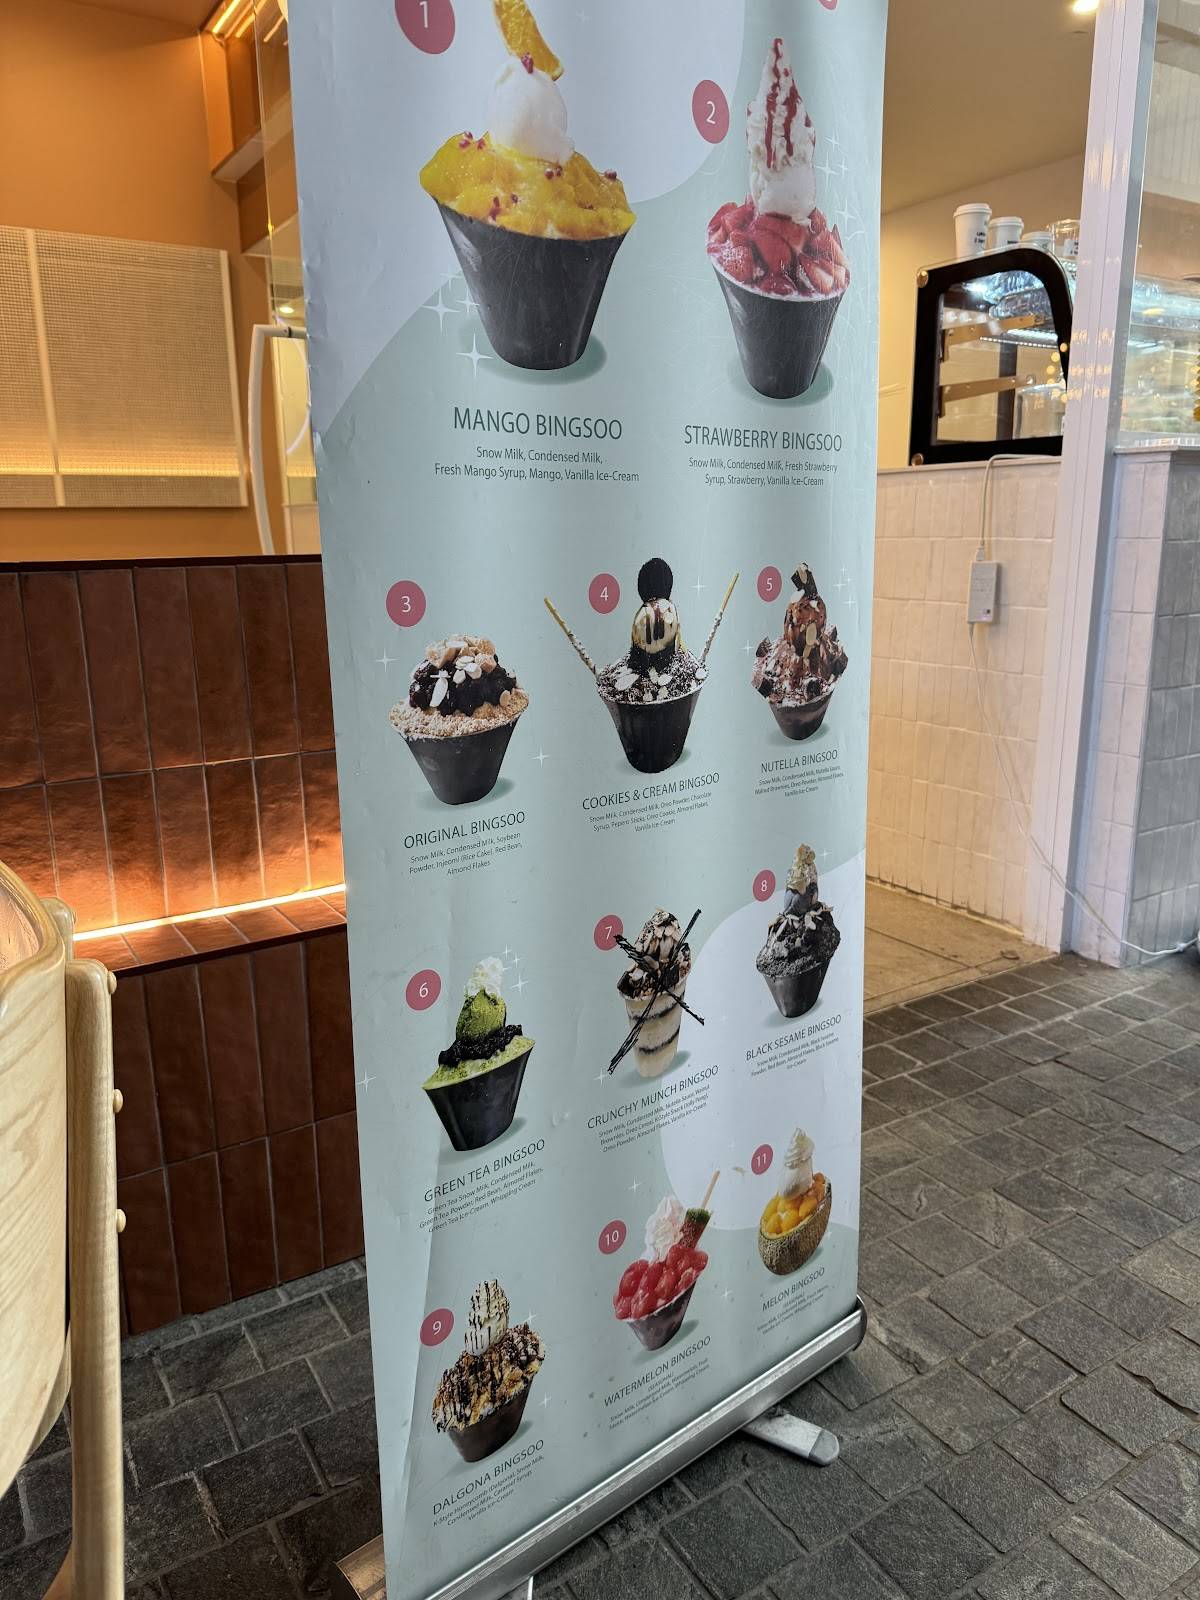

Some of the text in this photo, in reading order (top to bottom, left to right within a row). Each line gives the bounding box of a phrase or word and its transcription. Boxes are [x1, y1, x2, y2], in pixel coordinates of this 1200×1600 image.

[420, 0, 428, 28] 1
[706, 100, 716, 125] 2
[454, 406, 622, 440] MANGO BINGSOO
[684, 425, 842, 452] STRAWBERRY BINGSOO
[476, 446, 603, 465] Snow Milk, Condensed Milk,
[689, 457, 838, 473] Snow Milk, Condensed Milk, Fresh Strawberry
[434, 463, 640, 482] Fresh Mango Syrup, Mango, Vanilla Ice-Cream
[705, 474, 824, 487] Syrup, Strawberry, Vanilla Ice-Cream
[600, 586, 609, 601] 4
[766, 577, 773, 592] 5
[401, 595, 411, 613] 3
[761, 749, 838, 773] NUTELLA BINGSOO
[582, 772, 720, 810] COOKIES & CREAM BINGSOO
[404, 811, 526, 849] ORIGINAL BINGSOO
[410, 832, 521, 864] Snow Milk, Condensed Milk, Soybean
[447, 860, 491, 876] Almond Flakes
[761, 879, 768, 892] 8
[605, 925, 613, 940] 7
[419, 982, 429, 998] 6
[746, 1041, 773, 1061] BLACK
[774, 1028, 806, 1050] SESAME
[807, 1014, 842, 1037] BINGSOO
[587, 1065, 719, 1129] CRUNCHY MUNCH BINGSOO
[424, 1138, 545, 1202] GREEN TEA BINGSOO
[756, 1152, 767, 1168] 11
[419, 1216, 438, 1229] Green
[439, 1211, 450, 1219] Tea
[503, 1173, 525, 1189] Almond
[427, 1203, 446, 1215] Green
[447, 1198, 457, 1206] Tea
[458, 1190, 475, 1202] Snow
[476, 1183, 489, 1193] Milk,
[490, 1166, 521, 1186] Condensed
[604, 1230, 620, 1247] 10
[762, 1288, 790, 1312] MELON
[791, 1266, 825, 1294] BINGSOO
[432, 1320, 442, 1336] 9
[604, 1361, 669, 1407] WATERMELON
[671, 1336, 711, 1367] BINGSOO
[433, 1439, 544, 1515] DALGONA BINGSOO
